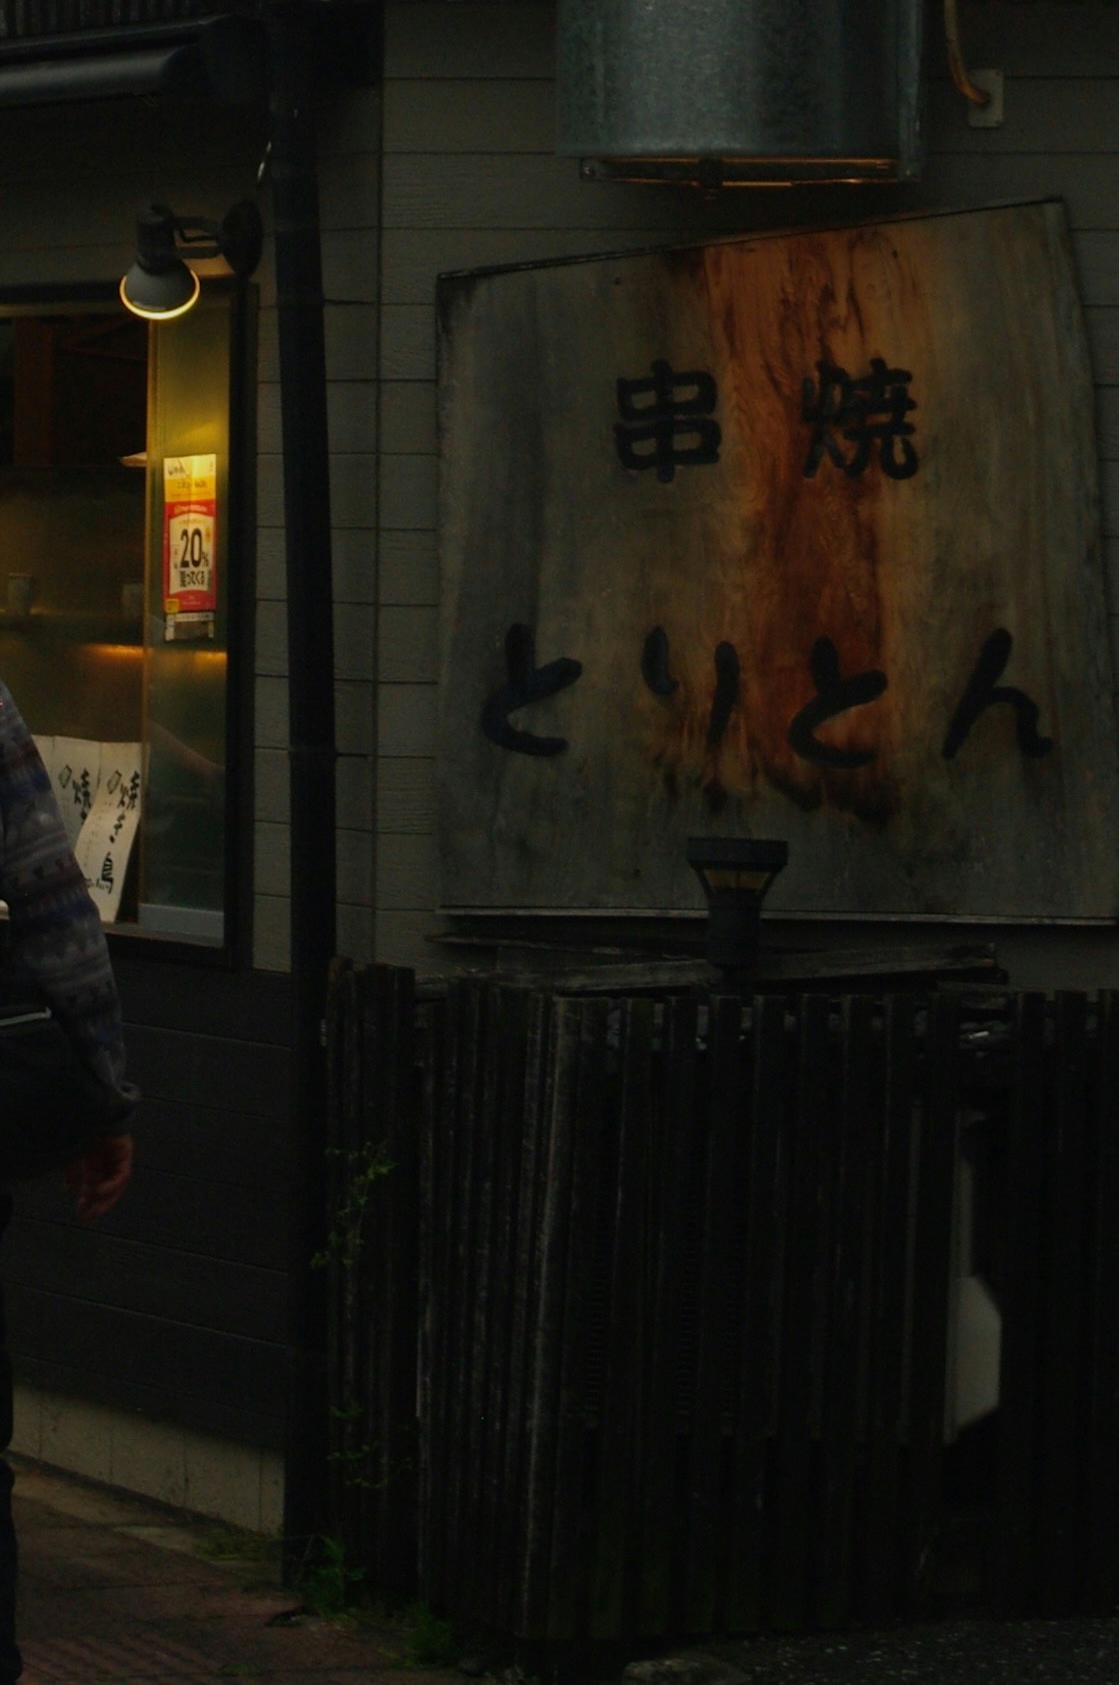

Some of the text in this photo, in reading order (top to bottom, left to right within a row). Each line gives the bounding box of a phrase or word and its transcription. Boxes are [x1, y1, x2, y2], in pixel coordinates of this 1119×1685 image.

[614, 359, 919, 483] 串焼
[483, 623, 1054, 768] とりとん
